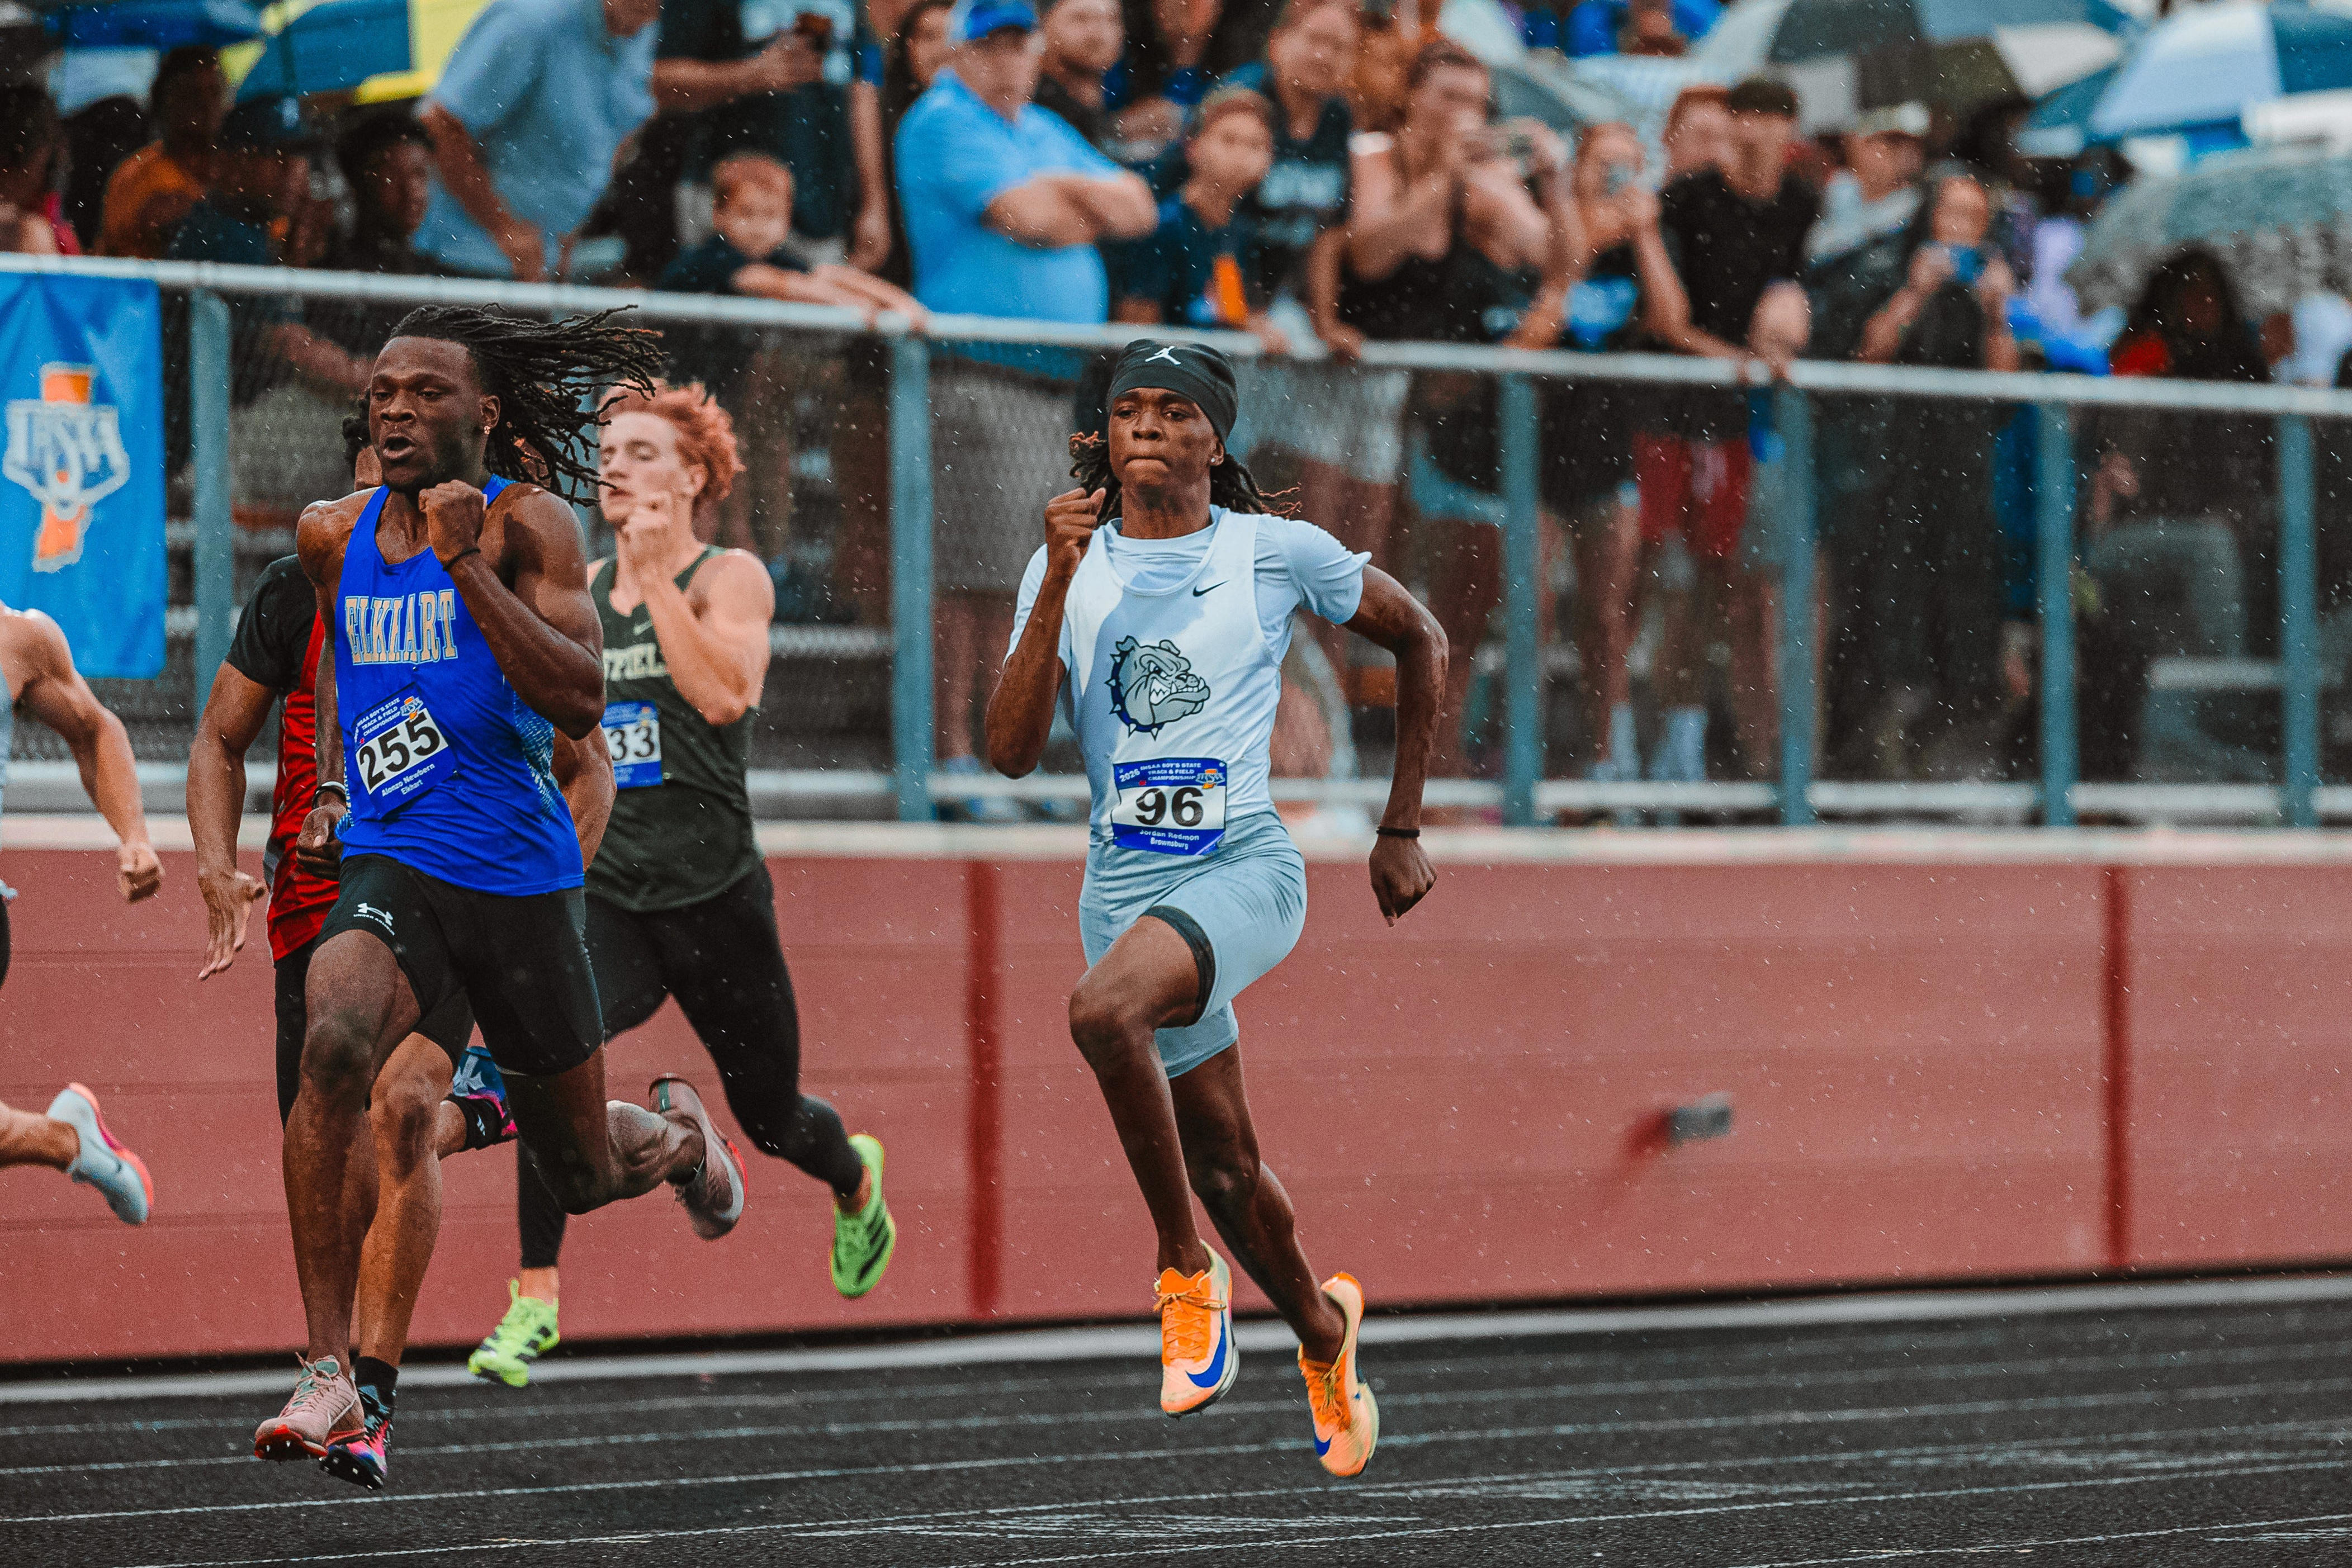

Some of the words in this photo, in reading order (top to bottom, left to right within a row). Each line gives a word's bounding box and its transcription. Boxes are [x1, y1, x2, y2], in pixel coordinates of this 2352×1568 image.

[344, 589, 458, 666] ELKHART
[385, 698, 401, 709] STATE
[361, 718, 378, 730] TRACK
[382, 706, 398, 717] FIELD
[363, 711, 401, 736] CHAMPIONSHIP
[359, 712, 440, 790] 255
[381, 780, 404, 797] Alonzo
[403, 764, 436, 783] Newbern
[401, 779, 423, 795] Elkhart
[1135, 787, 1204, 827] 96
[1139, 829, 1166, 837] Jordan
[1168, 832, 1200, 841] Redmon
[1150, 837, 1189, 850] Brownsburg
